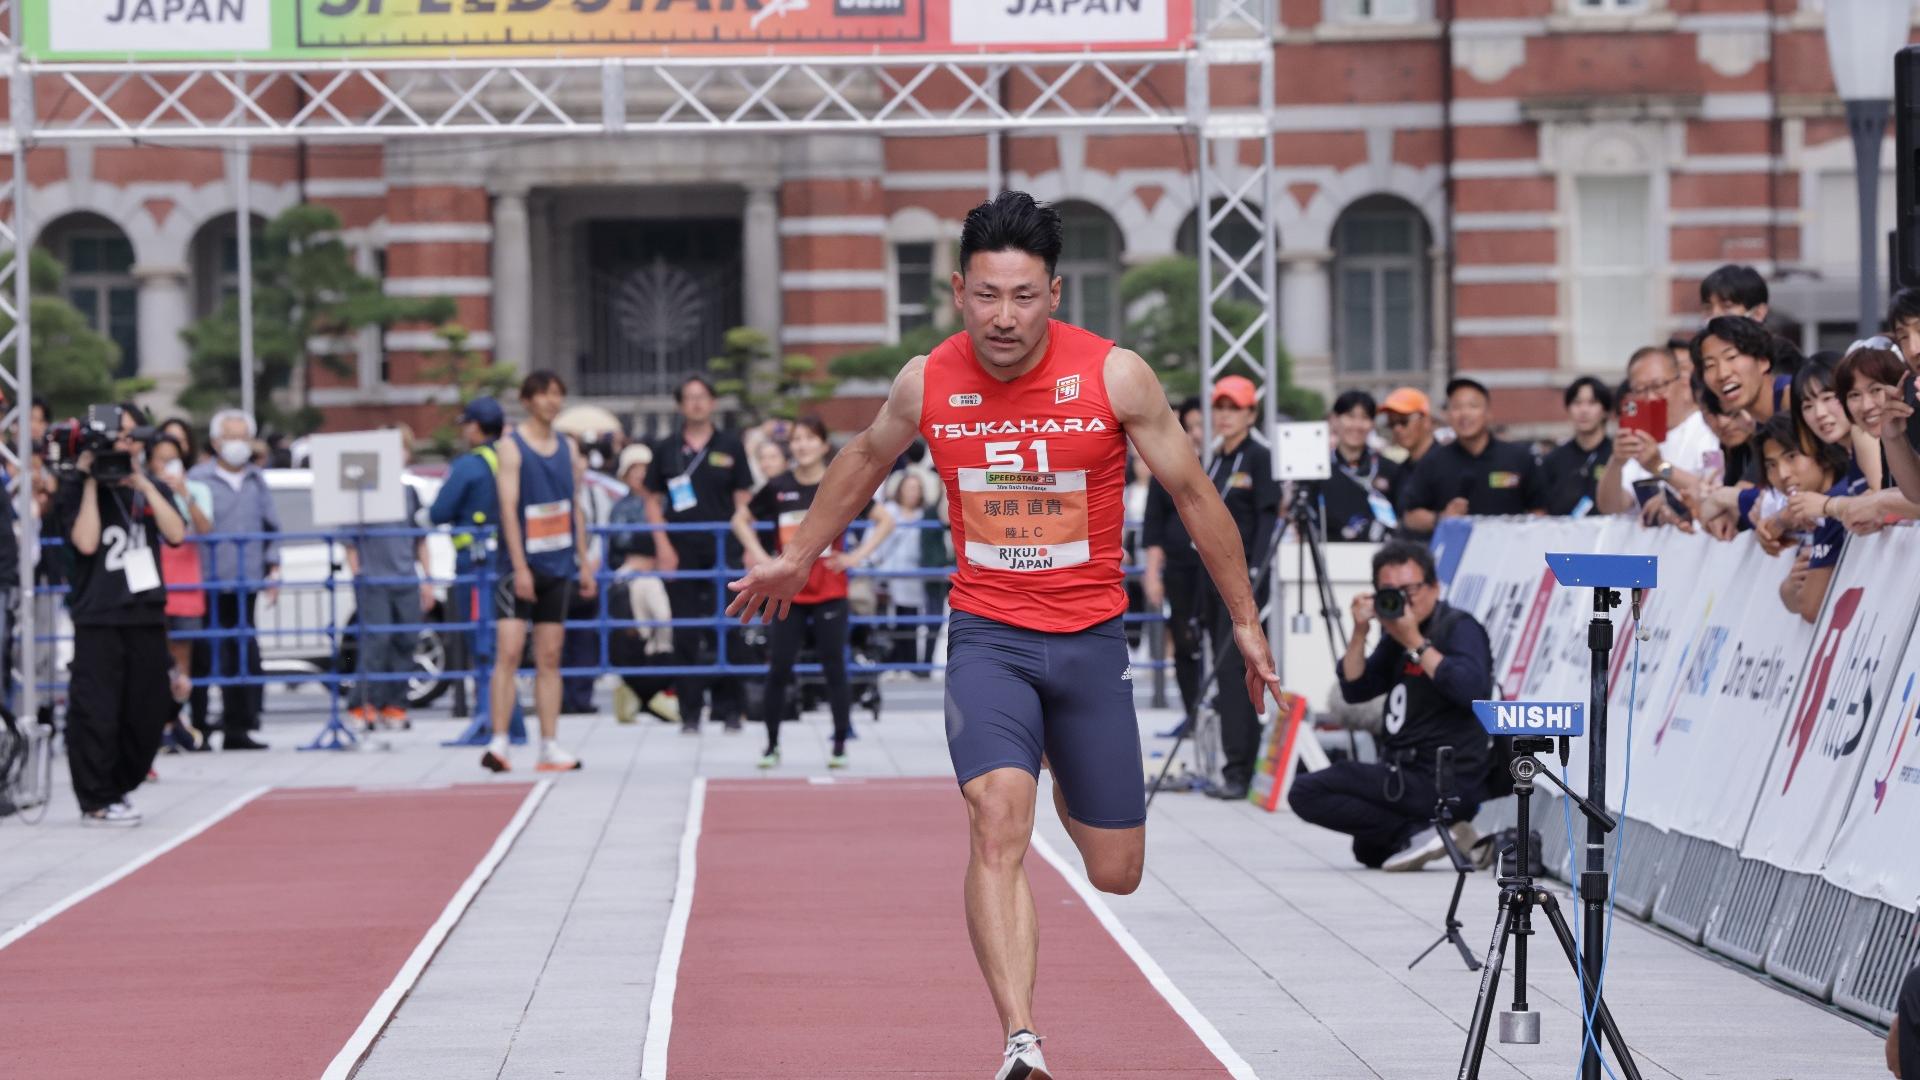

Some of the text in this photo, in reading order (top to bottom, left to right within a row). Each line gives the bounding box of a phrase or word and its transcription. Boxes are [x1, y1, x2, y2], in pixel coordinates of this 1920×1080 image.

[931, 417, 1107, 438] TSUKAHARA
[984, 440, 1049, 472] 51
[989, 474, 1016, 482] SPEED
[984, 498, 1063, 517] 塚原 直貴
[1005, 526, 1044, 539] 陸上 C
[1009, 557, 1053, 570] JAPAN
[1385, 683, 1407, 735] 9
[1497, 705, 1572, 728] NISHI
